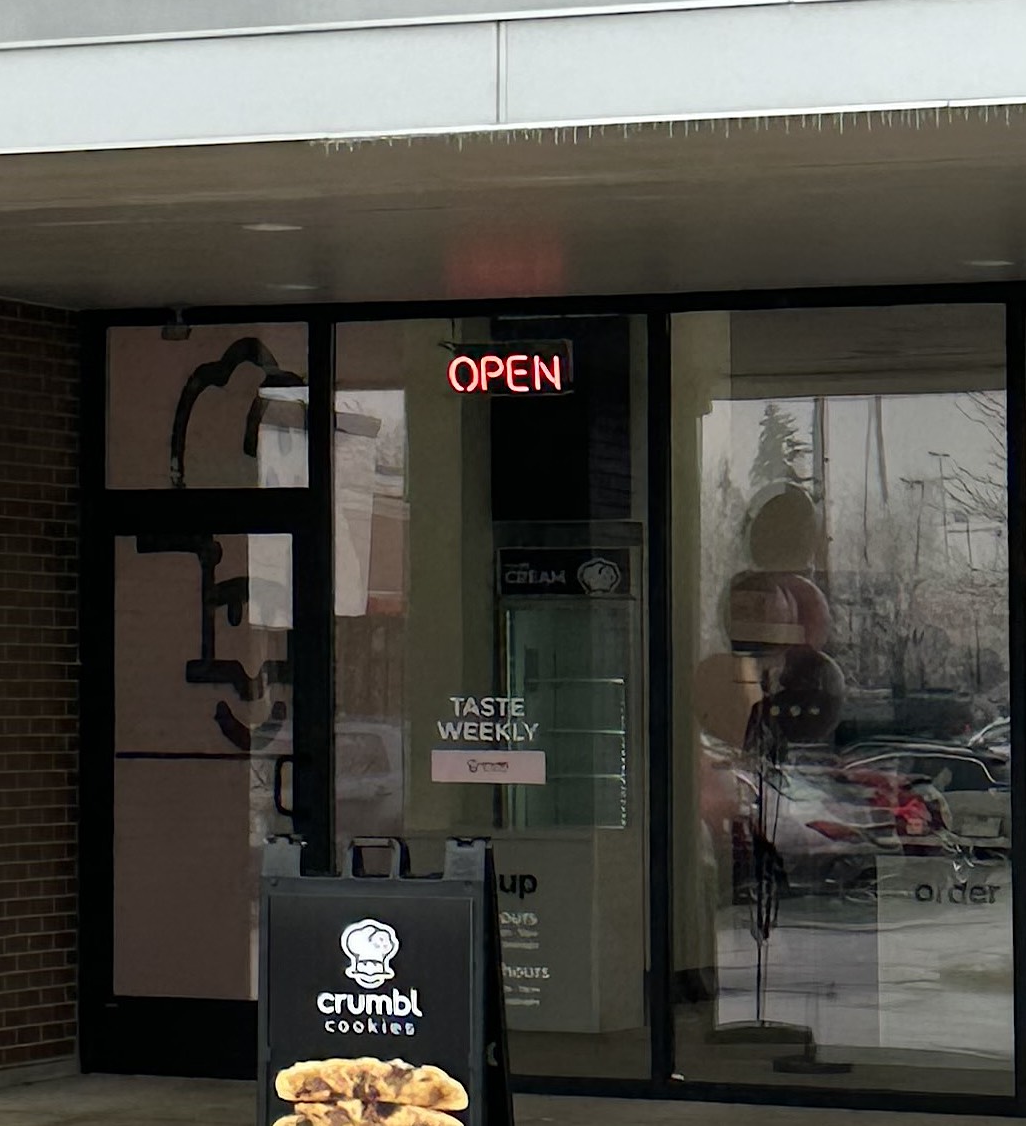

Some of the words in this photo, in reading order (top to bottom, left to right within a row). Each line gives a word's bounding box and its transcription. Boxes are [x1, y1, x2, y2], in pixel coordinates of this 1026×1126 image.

[448, 354, 562, 392] OPEN
[449, 696, 525, 718] TASTE
[437, 721, 539, 742] WEEKLY
[915, 876, 1001, 904] order
[316, 987, 424, 1018] crumbl
[324, 1017, 416, 1036] cookies
